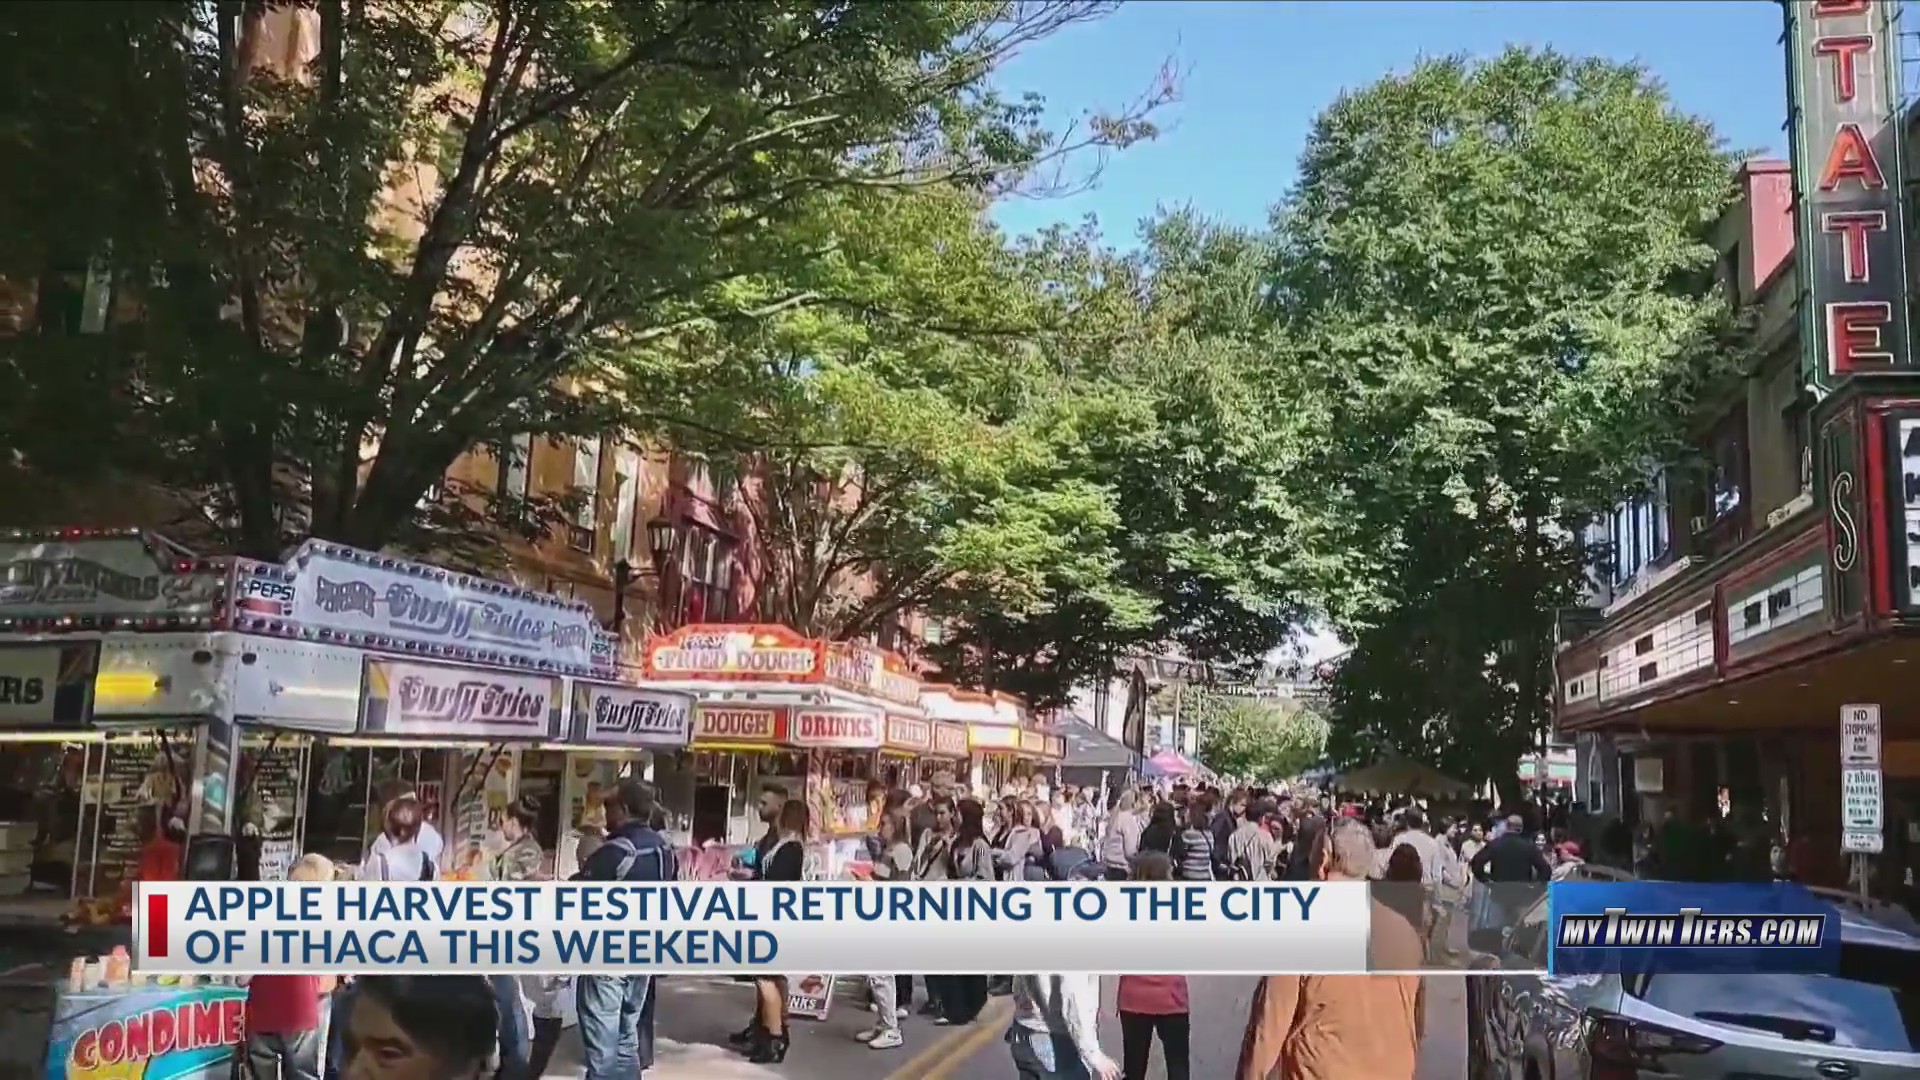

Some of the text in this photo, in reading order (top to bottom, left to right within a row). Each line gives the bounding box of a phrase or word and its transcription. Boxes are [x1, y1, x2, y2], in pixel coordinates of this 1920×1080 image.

[1811, 0, 1895, 375] TATE
[249, 580, 296, 601] PEPSI
[386, 582, 476, 639] Curly
[480, 602, 547, 643] Fries
[662, 650, 806, 671] FRIED DOUGH
[0, 676, 44, 705] RS
[399, 675, 545, 723] Curly Fries
[595, 695, 685, 733] Curly Fries
[703, 711, 770, 735] DOUGH
[800, 714, 874, 738] DRINKS
[1853, 710, 1868, 721] NO
[1845, 723, 1877, 736] STOPPING
[1854, 772, 1876, 784] HOUR
[1845, 785, 1878, 796] PARKING
[788, 995, 817, 1010] NKS
[72, 999, 248, 1069] CONDIME
